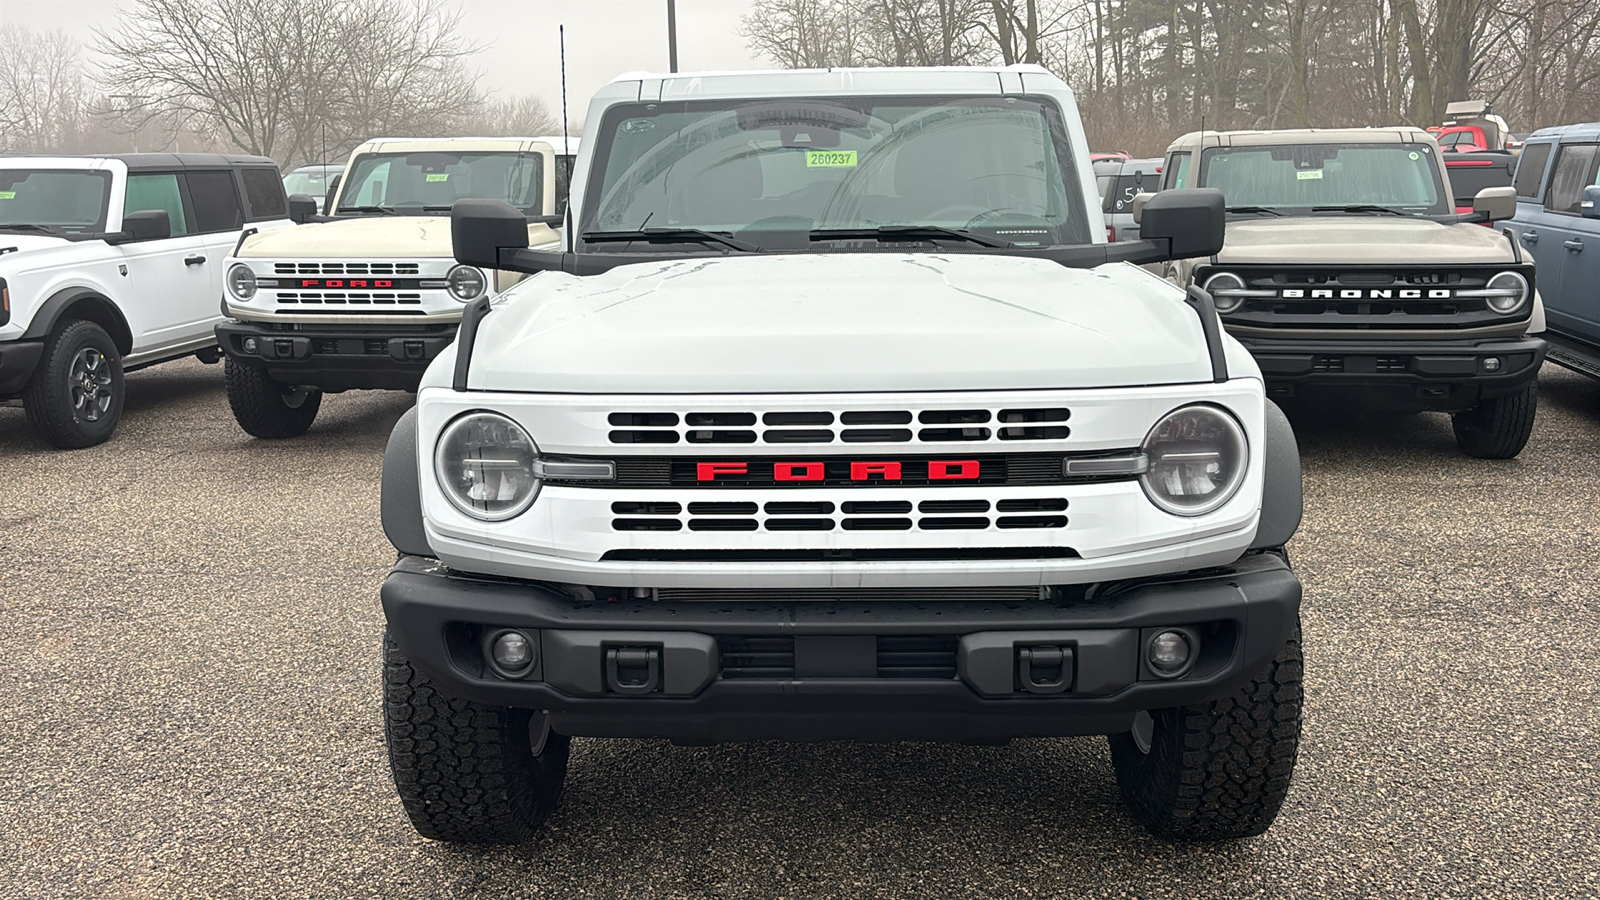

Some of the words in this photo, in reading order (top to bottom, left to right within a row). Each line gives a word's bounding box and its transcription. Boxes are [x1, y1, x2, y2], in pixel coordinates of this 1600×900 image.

[811, 154, 851, 165] 260237
[1282, 289, 1451, 298] BRONCO
[697, 460, 980, 481] FORD
